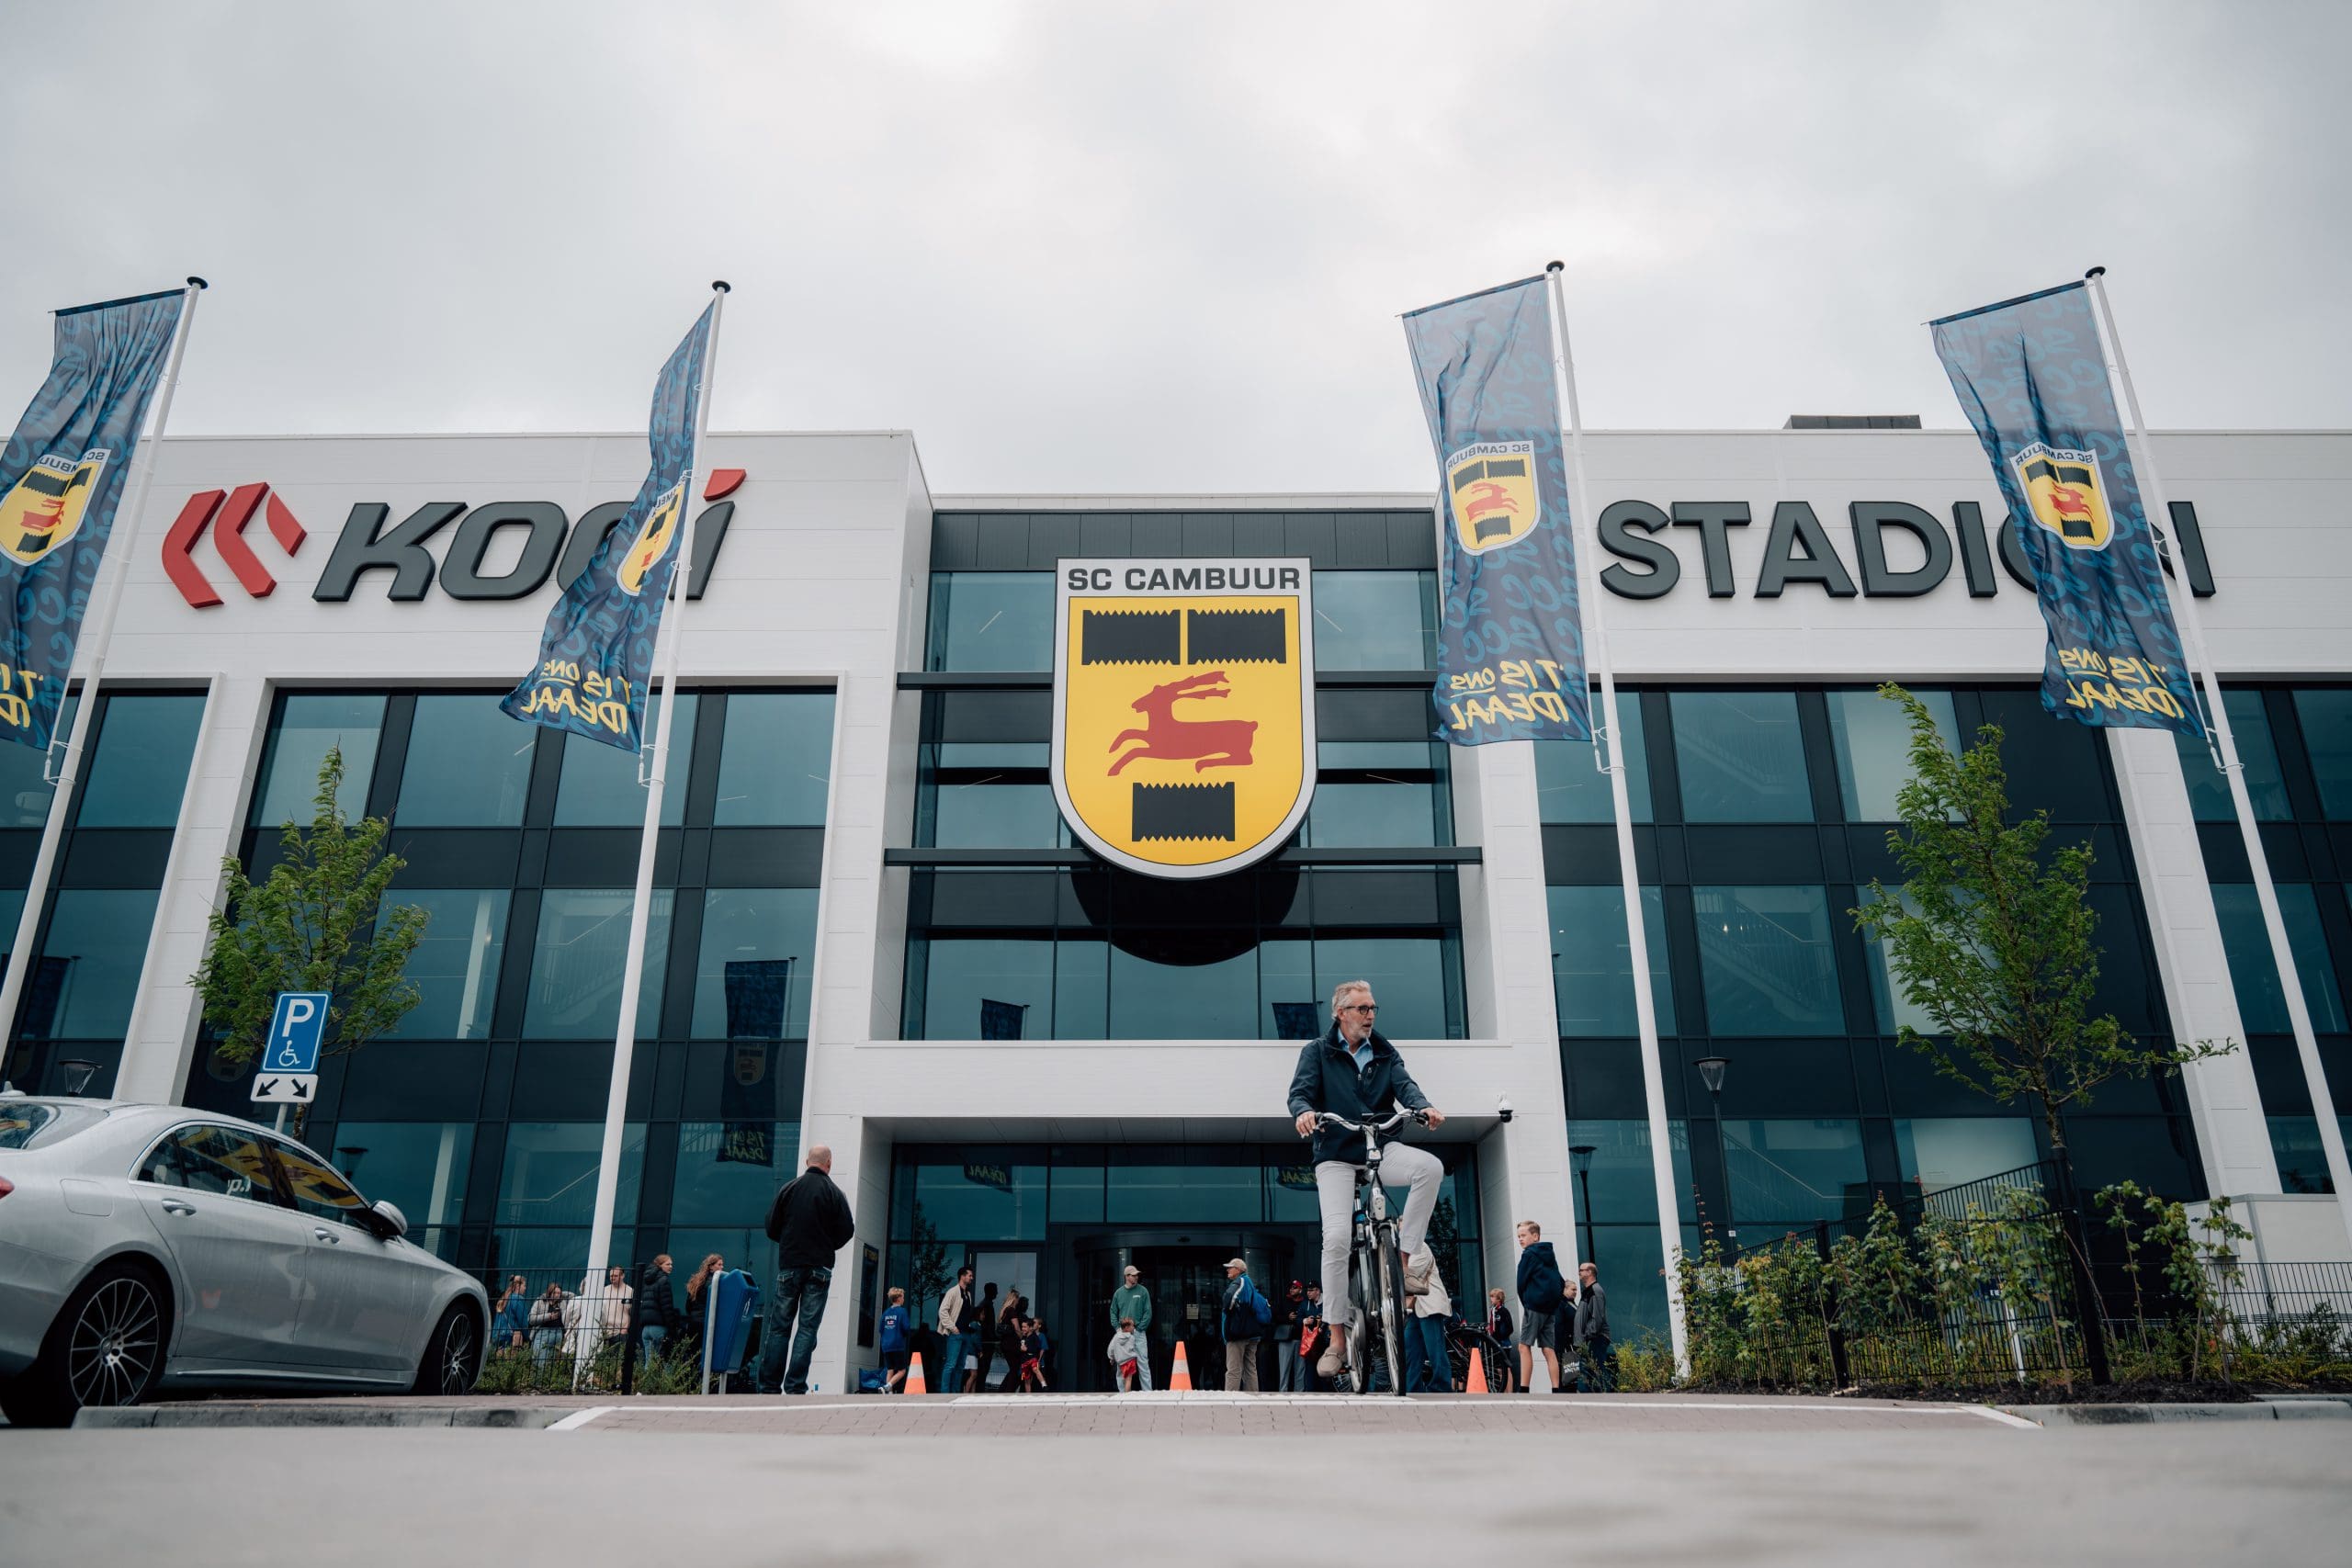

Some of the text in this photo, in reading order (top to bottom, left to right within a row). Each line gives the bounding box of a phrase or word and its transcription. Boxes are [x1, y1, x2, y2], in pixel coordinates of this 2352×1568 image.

[1598, 499, 2216, 600] STADI
[1068, 568, 1300, 591] SC CAMBUUR
[282, 998, 314, 1037] P
